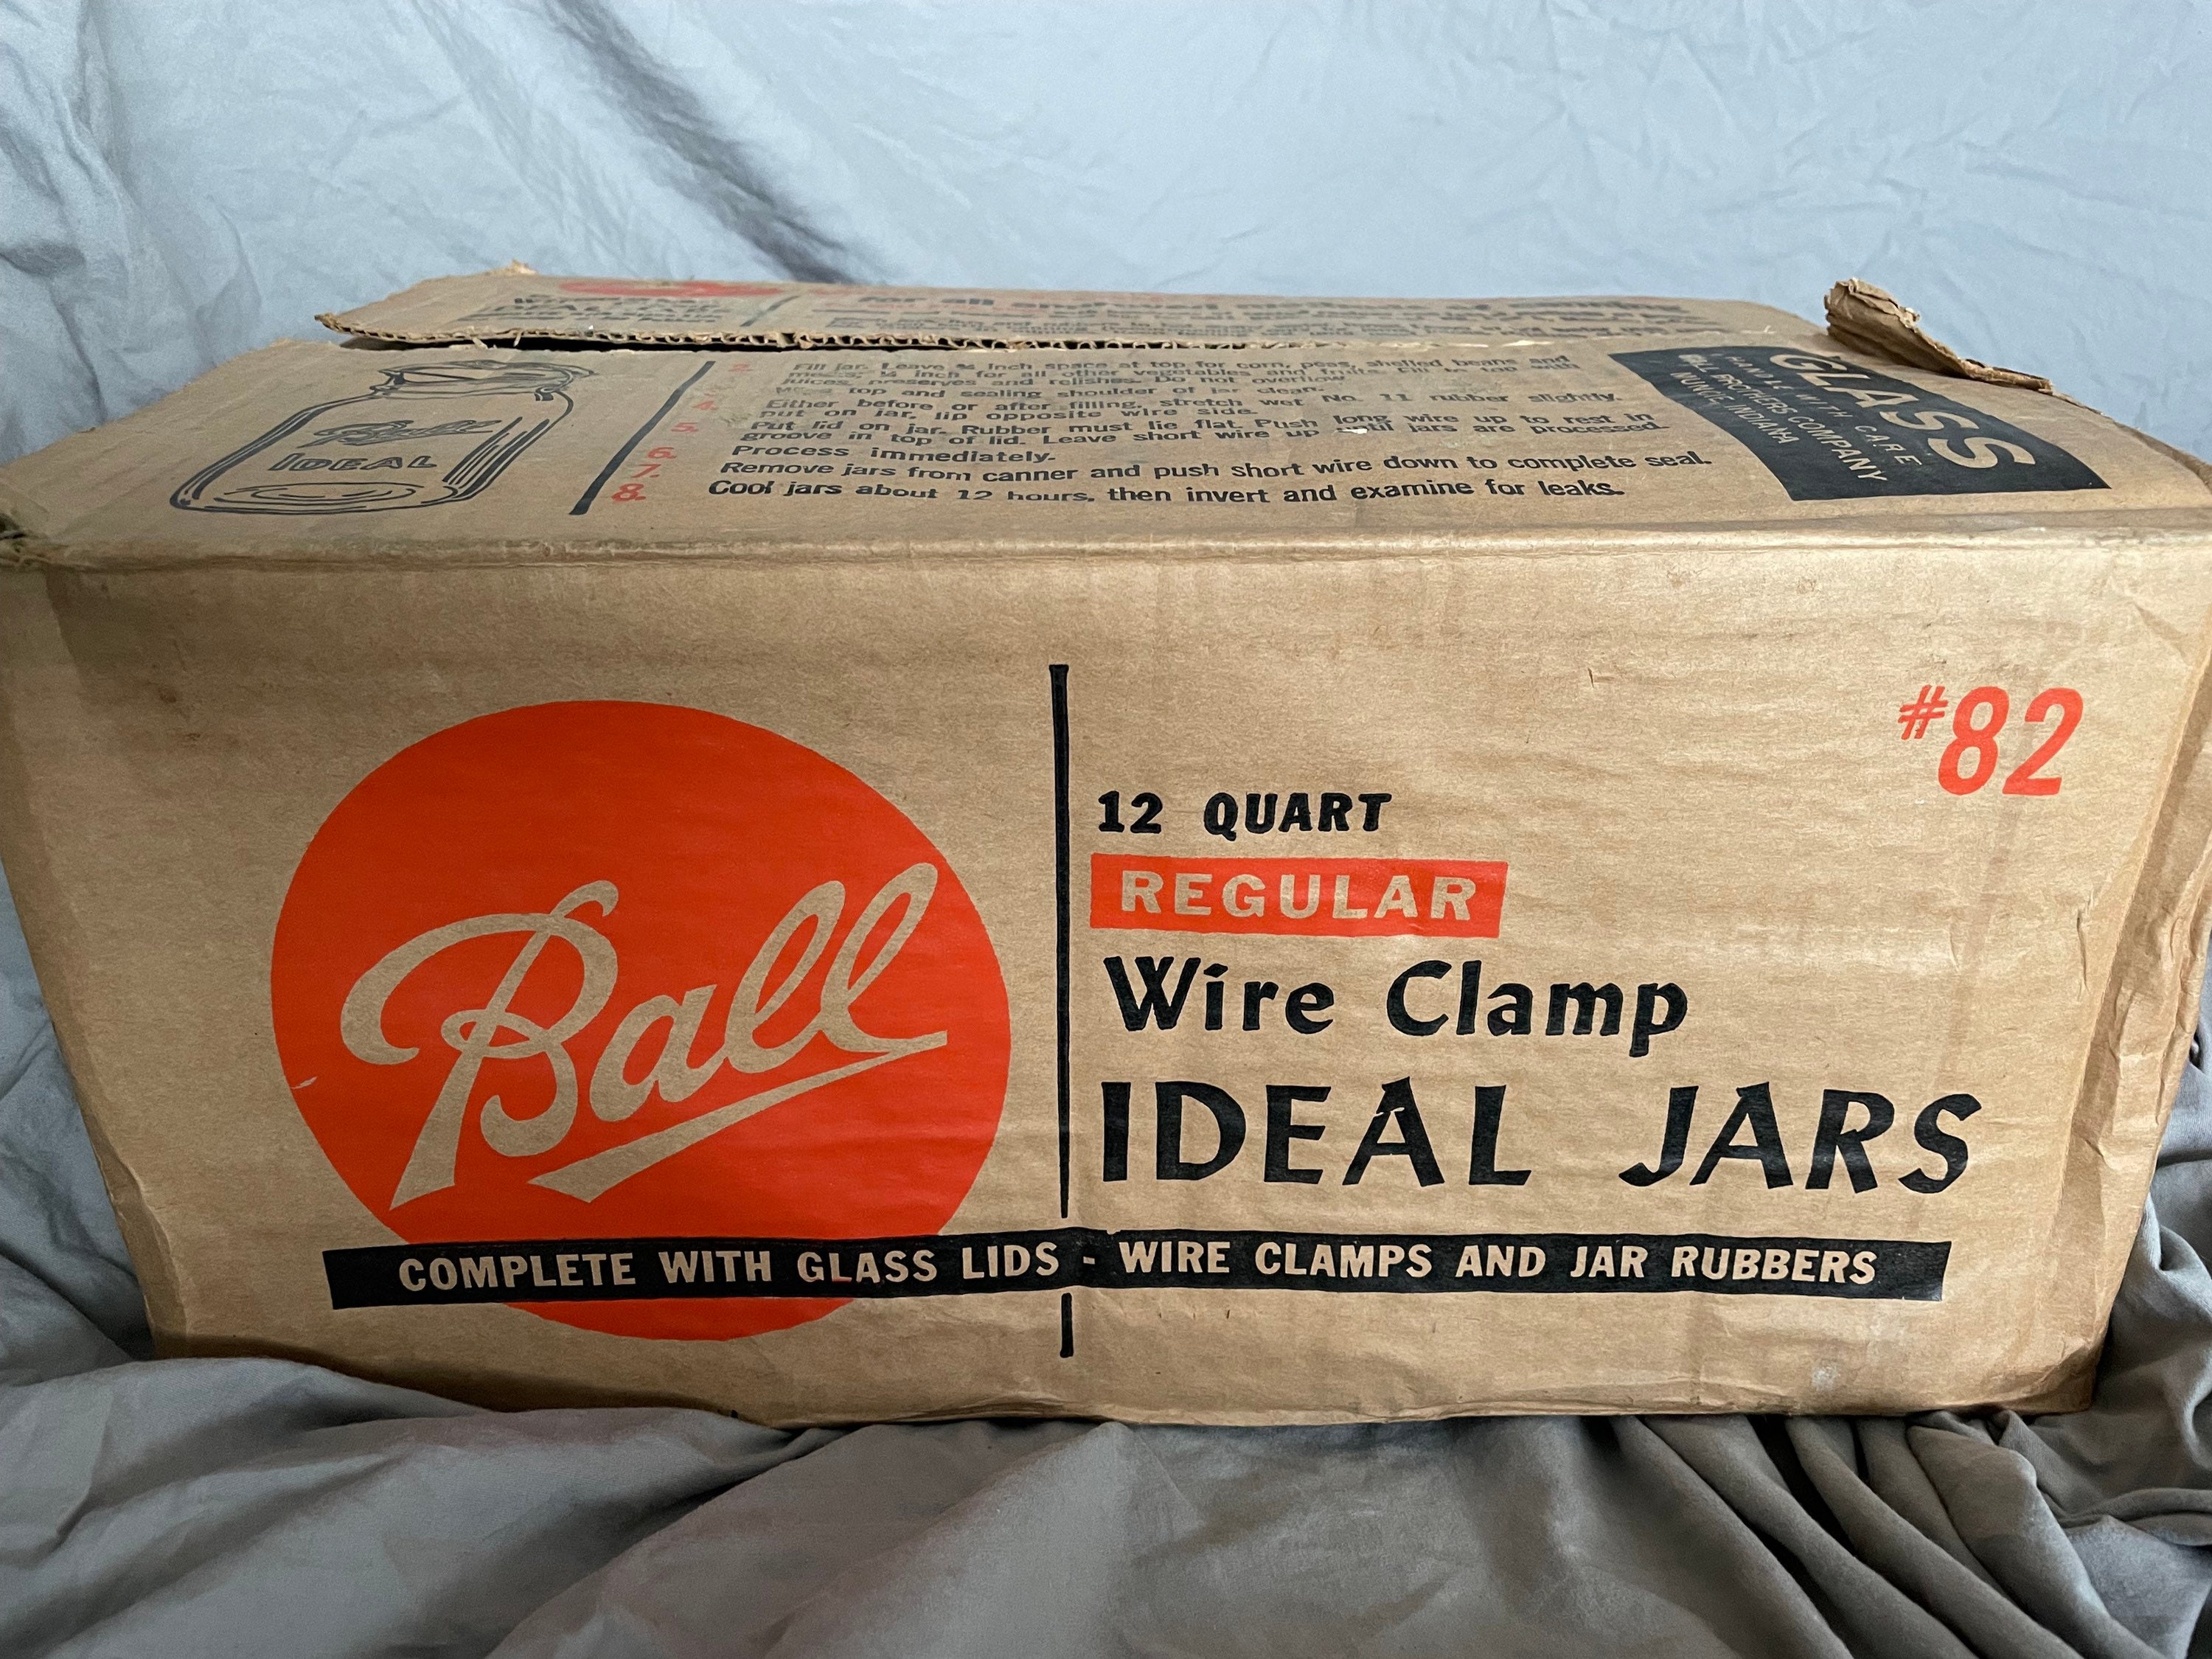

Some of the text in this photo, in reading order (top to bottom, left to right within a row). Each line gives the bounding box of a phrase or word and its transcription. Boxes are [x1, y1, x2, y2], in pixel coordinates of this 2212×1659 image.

[882, 362, 945, 371] Leave
[1150, 361, 1185, 369] top
[914, 370, 959, 378] inch
[1133, 369, 1252, 378] vegetables
[768, 399, 839, 409] Either
[857, 399, 933, 411] before
[951, 403, 978, 411] or
[995, 401, 1050, 411] after
[1159, 398, 1243, 406] stretch
[1380, 394, 1413, 402] 11
[1429, 394, 1509, 403] rubber
[849, 387, 886, 395] top
[961, 389, 1042, 399] sealing
[1057, 388, 1158, 397] shoulder
[751, 421, 797, 431] Put
[811, 420, 844, 430] lid
[858, 422, 891, 431] on
[906, 423, 947, 434] jar.
[961, 425, 1053, 435] Rubber
[1068, 421, 1134, 433] must
[1147, 420, 1178, 431] lie
[1194, 419, 1243, 429] flat.
[1253, 418, 1318, 428] Push
[1333, 415, 1392, 425] long
[1402, 414, 1460, 423] wire
[1473, 415, 1509, 424] up
[1519, 414, 1550, 424] to
[1562, 414, 1617, 425] rest
[1623, 413, 1655, 422] in
[759, 409, 806, 419] put
[824, 408, 858, 417] on
[933, 411, 968, 421] lip
[986, 410, 1102, 421] opposite
[1120, 408, 1178, 417] wire
[1711, 374, 1798, 414] BROTHERS
[1788, 416, 1888, 481] COMPANY
[1723, 403, 1800, 444] INDIANA
[1770, 354, 2037, 469] GLASS
[1796, 394, 1853, 417] WITH
[1855, 425, 1922, 465] CARE
[740, 432, 832, 442] groove
[847, 431, 873, 440] in
[890, 434, 933, 446] top
[948, 435, 977, 445] of
[988, 435, 1026, 445] lid.
[1043, 435, 1117, 445] Leave
[1133, 431, 1203, 442] short
[1214, 429, 1270, 439] wire
[1285, 430, 1321, 438] up
[1407, 423, 1458, 433] jars
[1472, 425, 1517, 433] are
[1529, 421, 1671, 434] processed.
[267, 452, 438, 472] IDEAL
[631, 451, 1713, 482] 7. Remove jars from canner and push short wire down to complete seal.
[731, 445, 850, 456] Process
[870, 447, 1057, 464] immediately.
[611, 483, 647, 502] 8.
[708, 479, 775, 495] Cool
[782, 481, 843, 496] jars
[855, 484, 939, 499] about
[958, 490, 994, 501] 12
[1107, 487, 1172, 502] then
[1186, 487, 1271, 503] invert
[1282, 484, 1338, 503] and
[1350, 479, 1475, 500] examine
[1484, 478, 1526, 495] for
[1537, 479, 1626, 496] leaks.
[1897, 684, 2084, 796] #82
[1097, 790, 1393, 842] 12 QUART
[1120, 869, 1478, 921] REGULAR
[1103, 956, 1688, 1057] Wire Clamp
[340, 862, 948, 1211] Ball
[1100, 1075, 1983, 1194] IDEAL JARS
[398, 1251, 636, 1293] COMPLETE
[658, 1250, 773, 1284] WITH
[796, 1249, 939, 1284] GLASS
[961, 1241, 1060, 1280] LIDS
[1119, 1240, 1231, 1275] WIRE
[1253, 1240, 1433, 1278] CLAMPS
[1454, 1244, 1548, 1279] AND
[1569, 1245, 1649, 1279] JAR
[1670, 1245, 1877, 1286] RUBBERS
